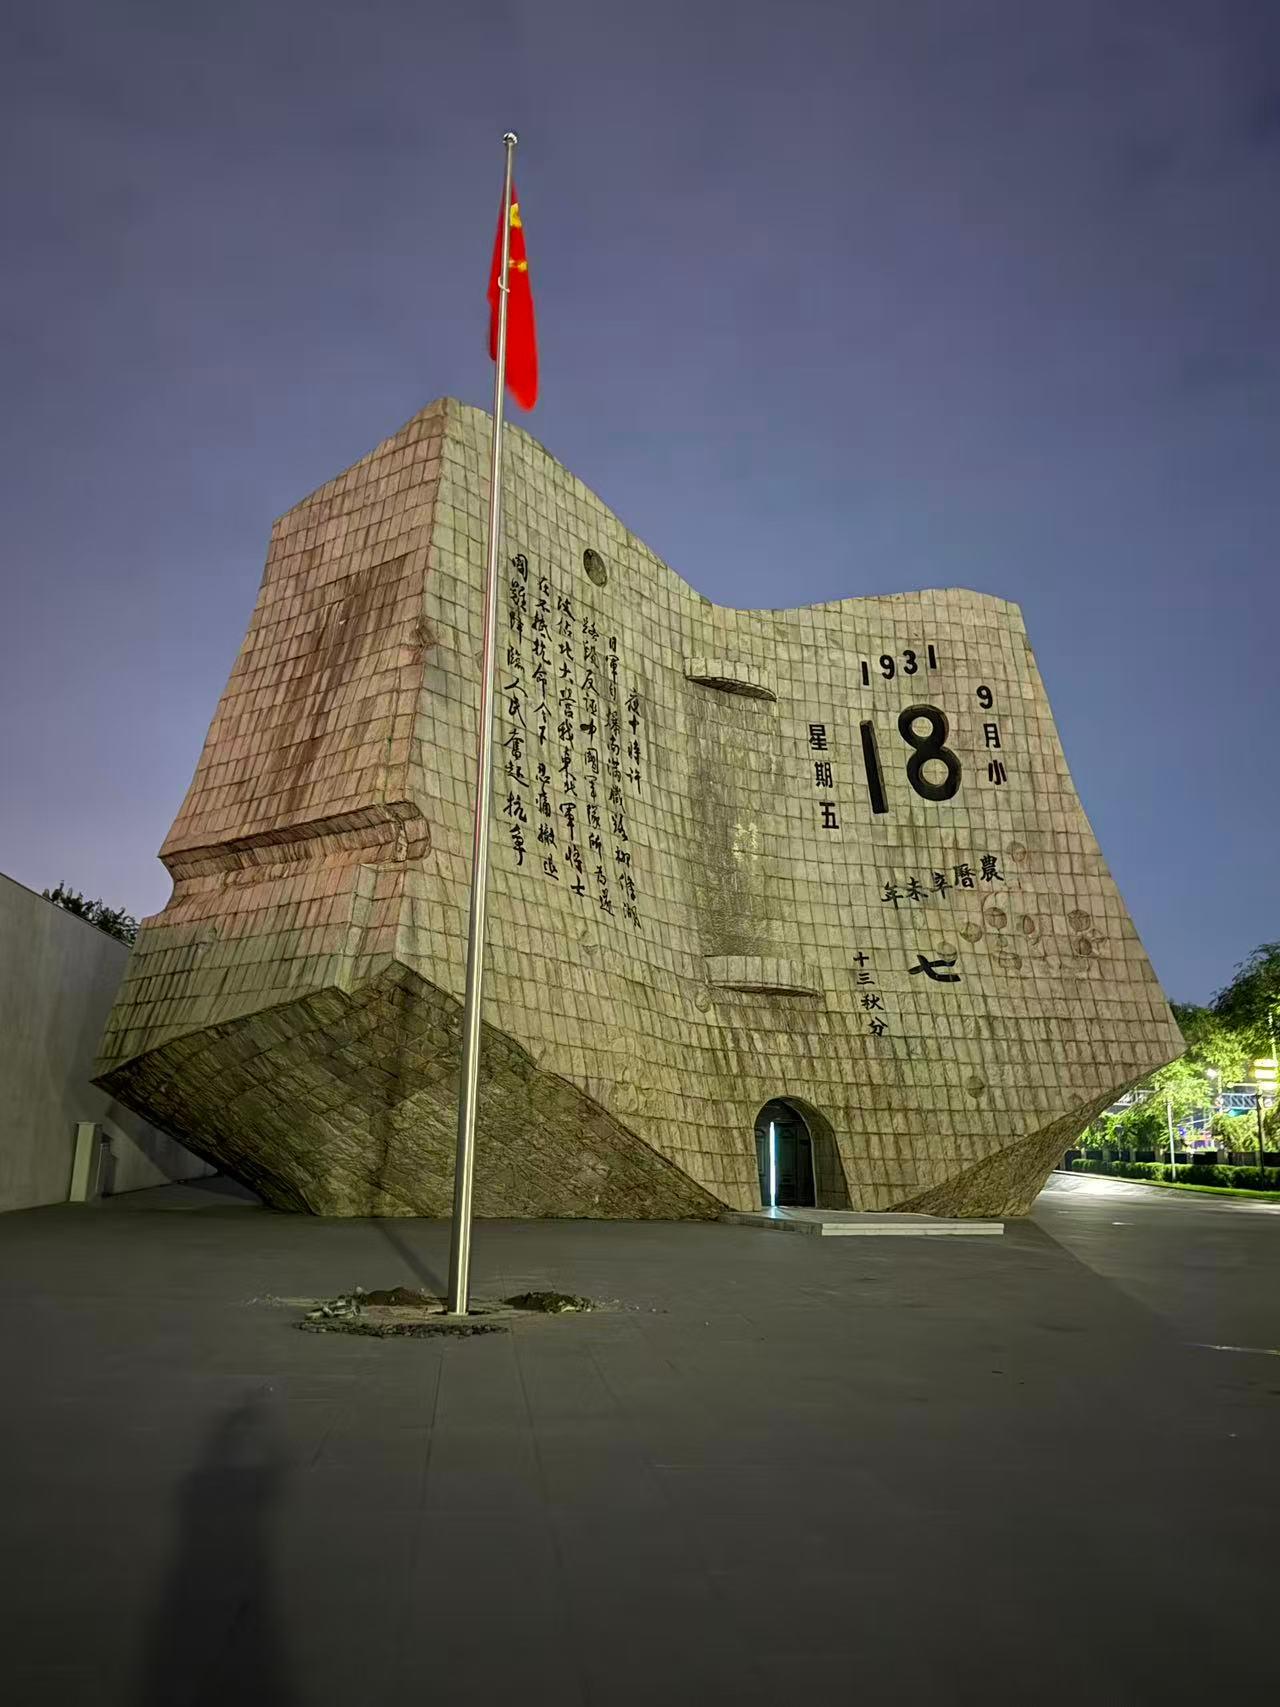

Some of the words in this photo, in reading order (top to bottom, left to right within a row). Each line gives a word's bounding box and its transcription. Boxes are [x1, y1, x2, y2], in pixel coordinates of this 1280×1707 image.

[861, 645, 937, 686] 1931
[808, 724, 839, 829] 星期五
[860, 704, 962, 814] 18
[976, 685, 1007, 785] 9月小
[908, 954, 961, 983] 七
